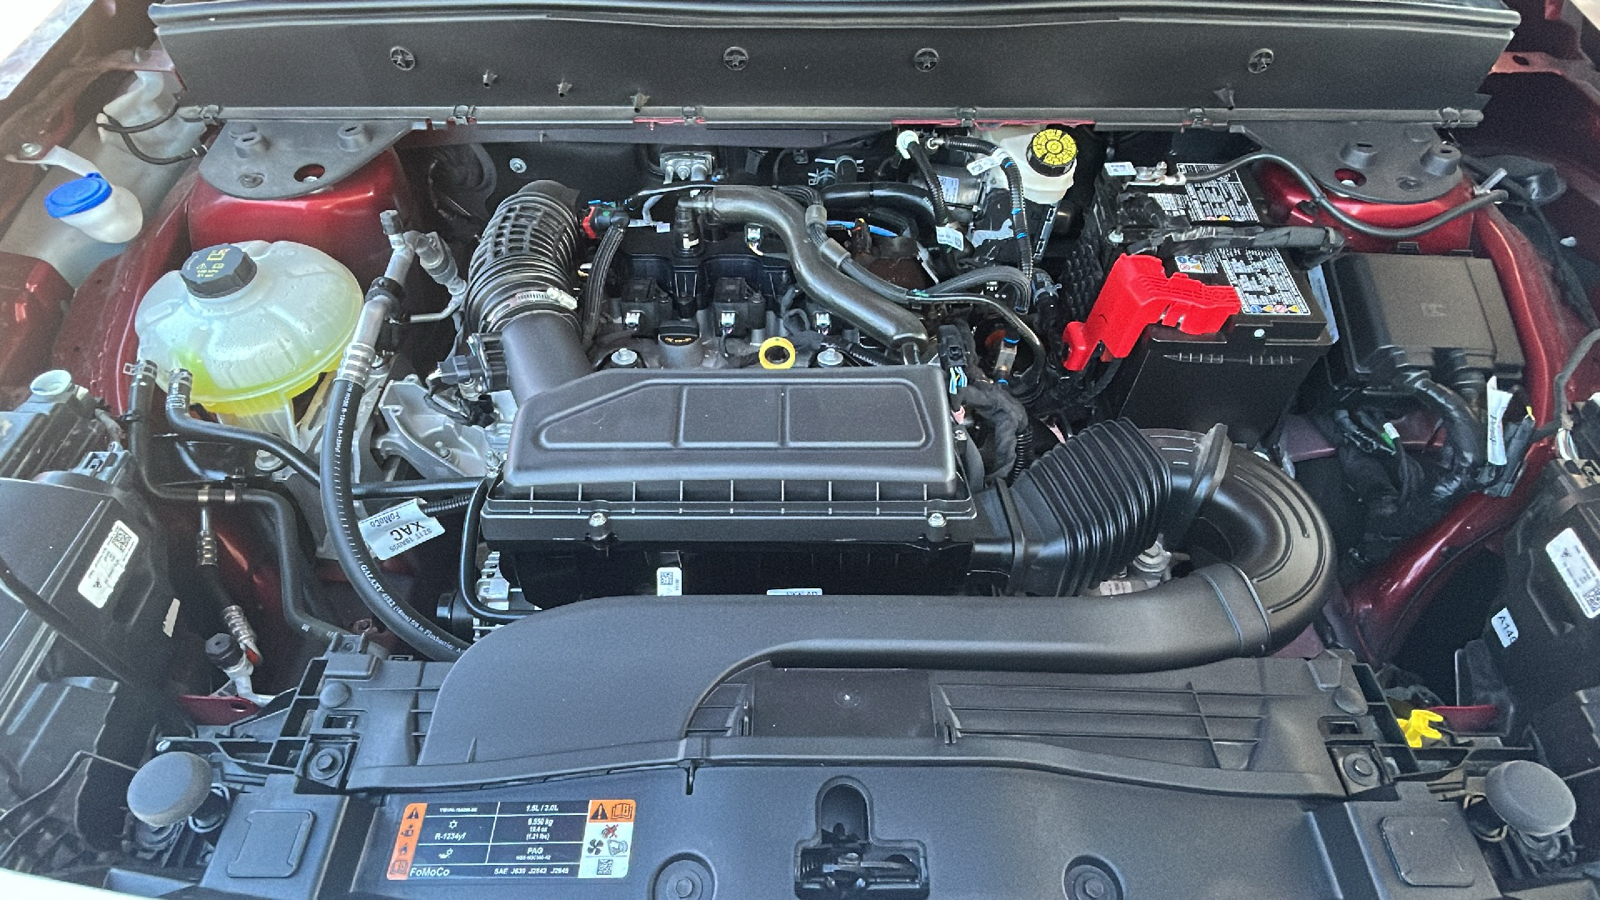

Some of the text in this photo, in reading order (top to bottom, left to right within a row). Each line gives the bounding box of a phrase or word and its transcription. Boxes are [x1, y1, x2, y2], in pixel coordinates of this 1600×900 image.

[370, 511, 401, 527] FoMoCo
[390, 521, 426, 541] XAC
[360, 564, 384, 592] GALAXY
[526, 804, 539, 812] 1.5L
[544, 804, 558, 812] 2.0L
[545, 818, 554, 827] kg
[434, 832, 467, 841] R-1234yf
[409, 867, 450, 877] FoMoCo
[494, 867, 508, 875] SAE
